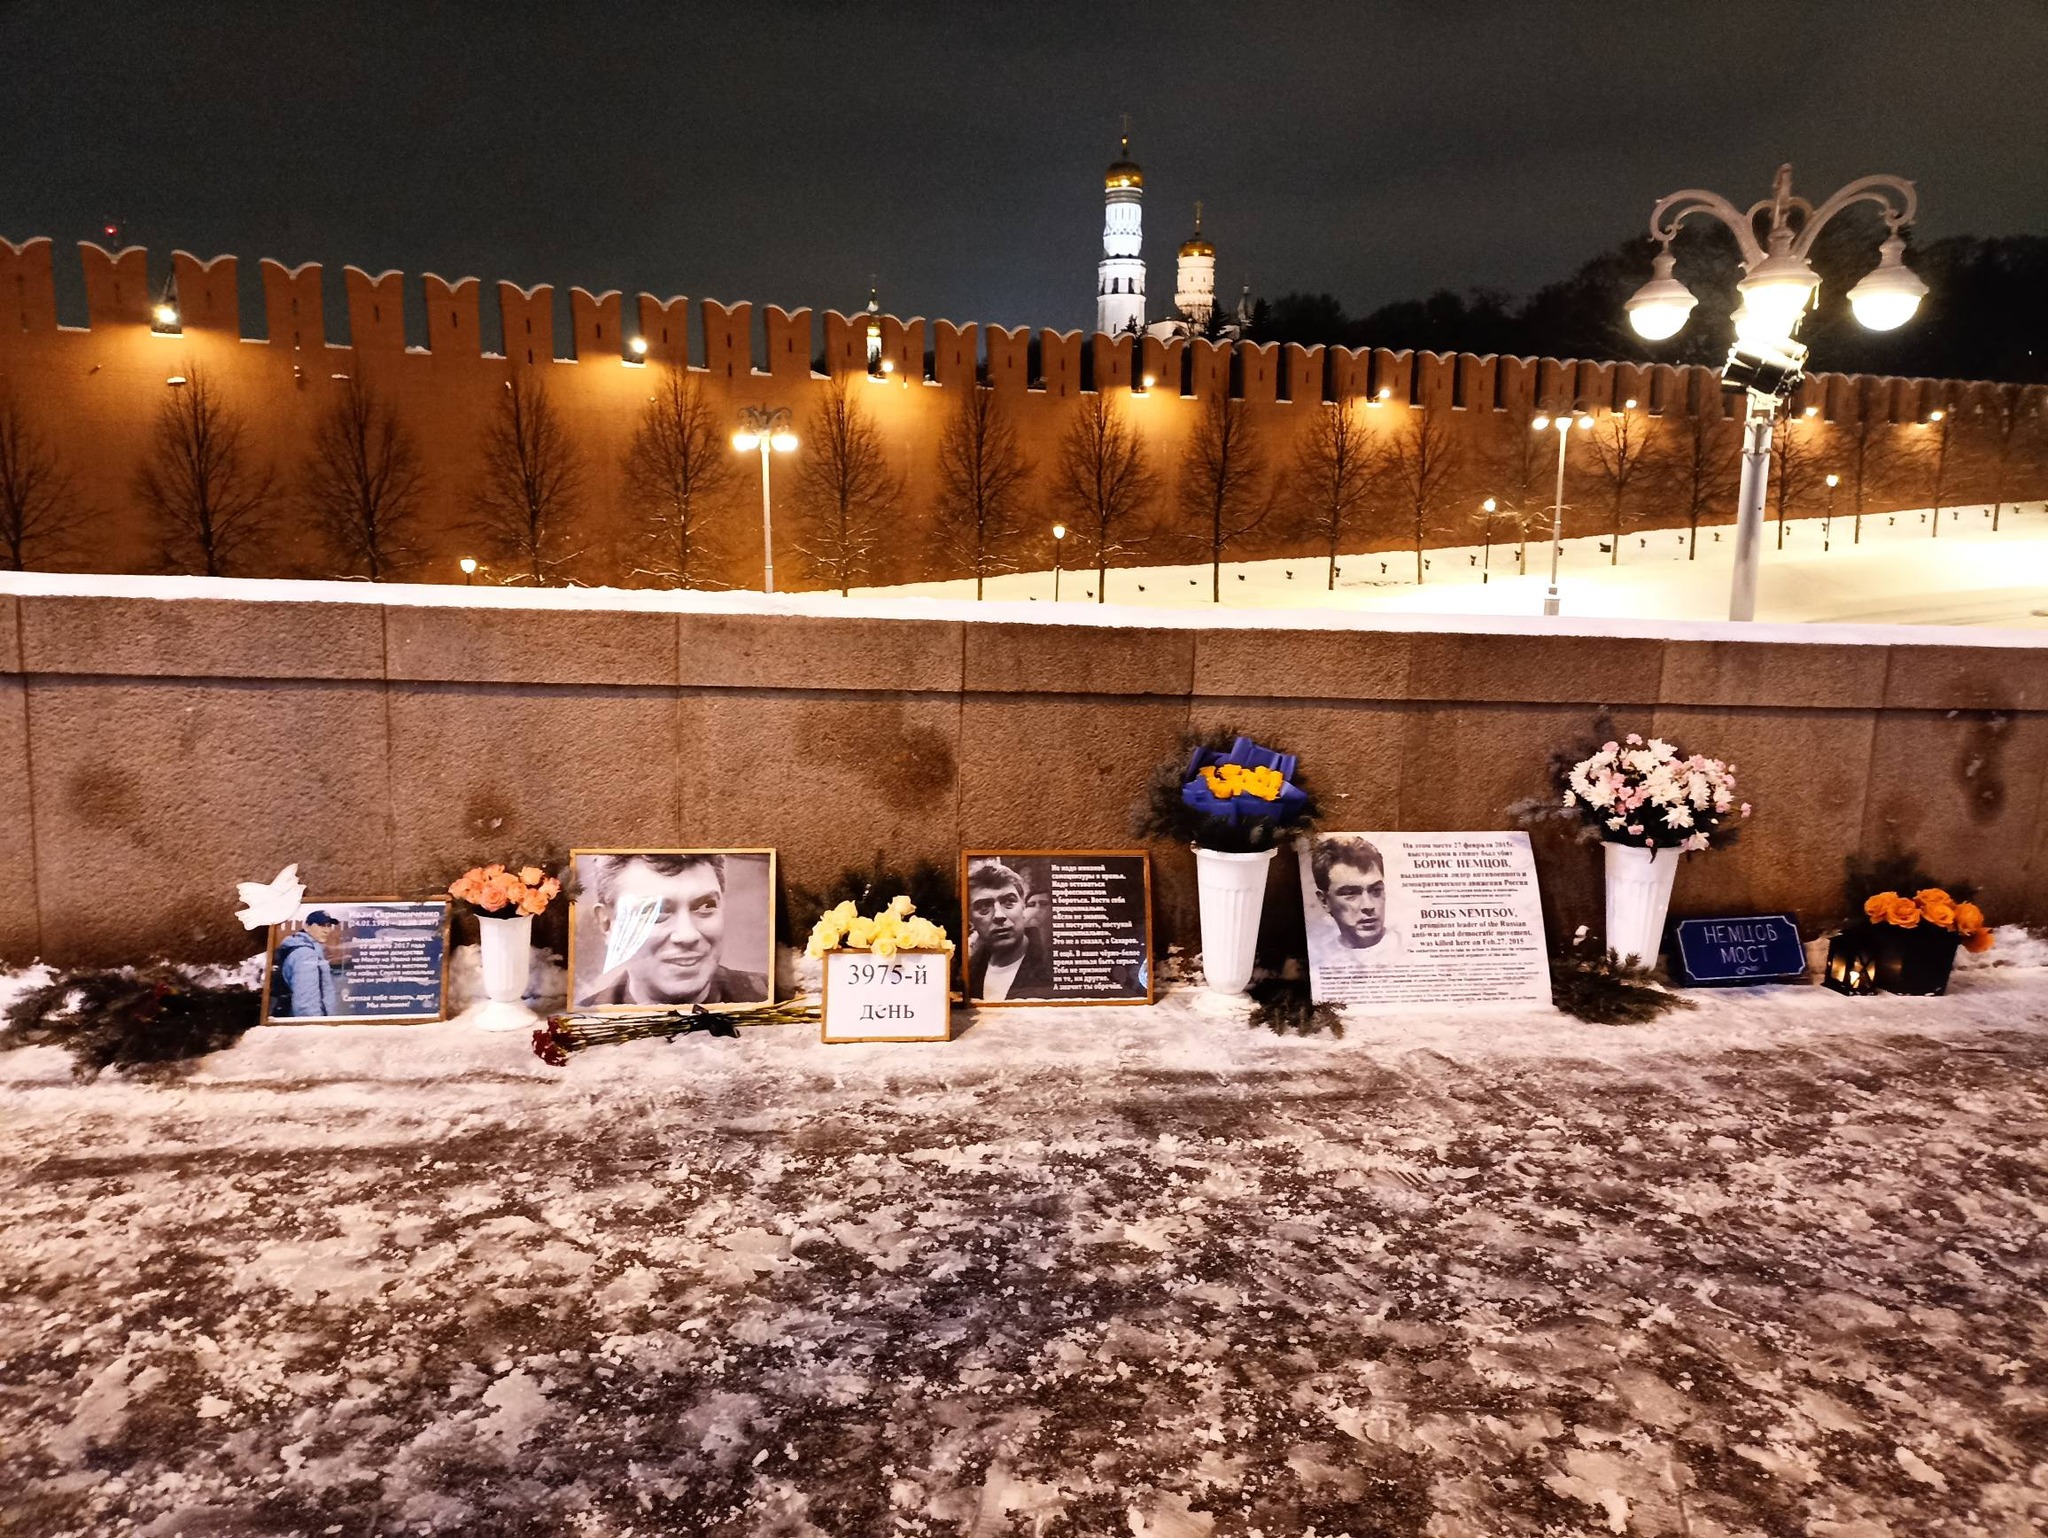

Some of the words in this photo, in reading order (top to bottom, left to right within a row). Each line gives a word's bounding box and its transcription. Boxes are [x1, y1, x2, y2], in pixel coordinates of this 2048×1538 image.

[1414, 859, 1454, 869] БОРИС
[1420, 909, 1456, 919] BORIS
[1419, 922, 1455, 930] prominent
[1720, 944, 1768, 963] МОСТ
[848, 964, 928, 985] 3975-й
[859, 1004, 915, 1021] день
